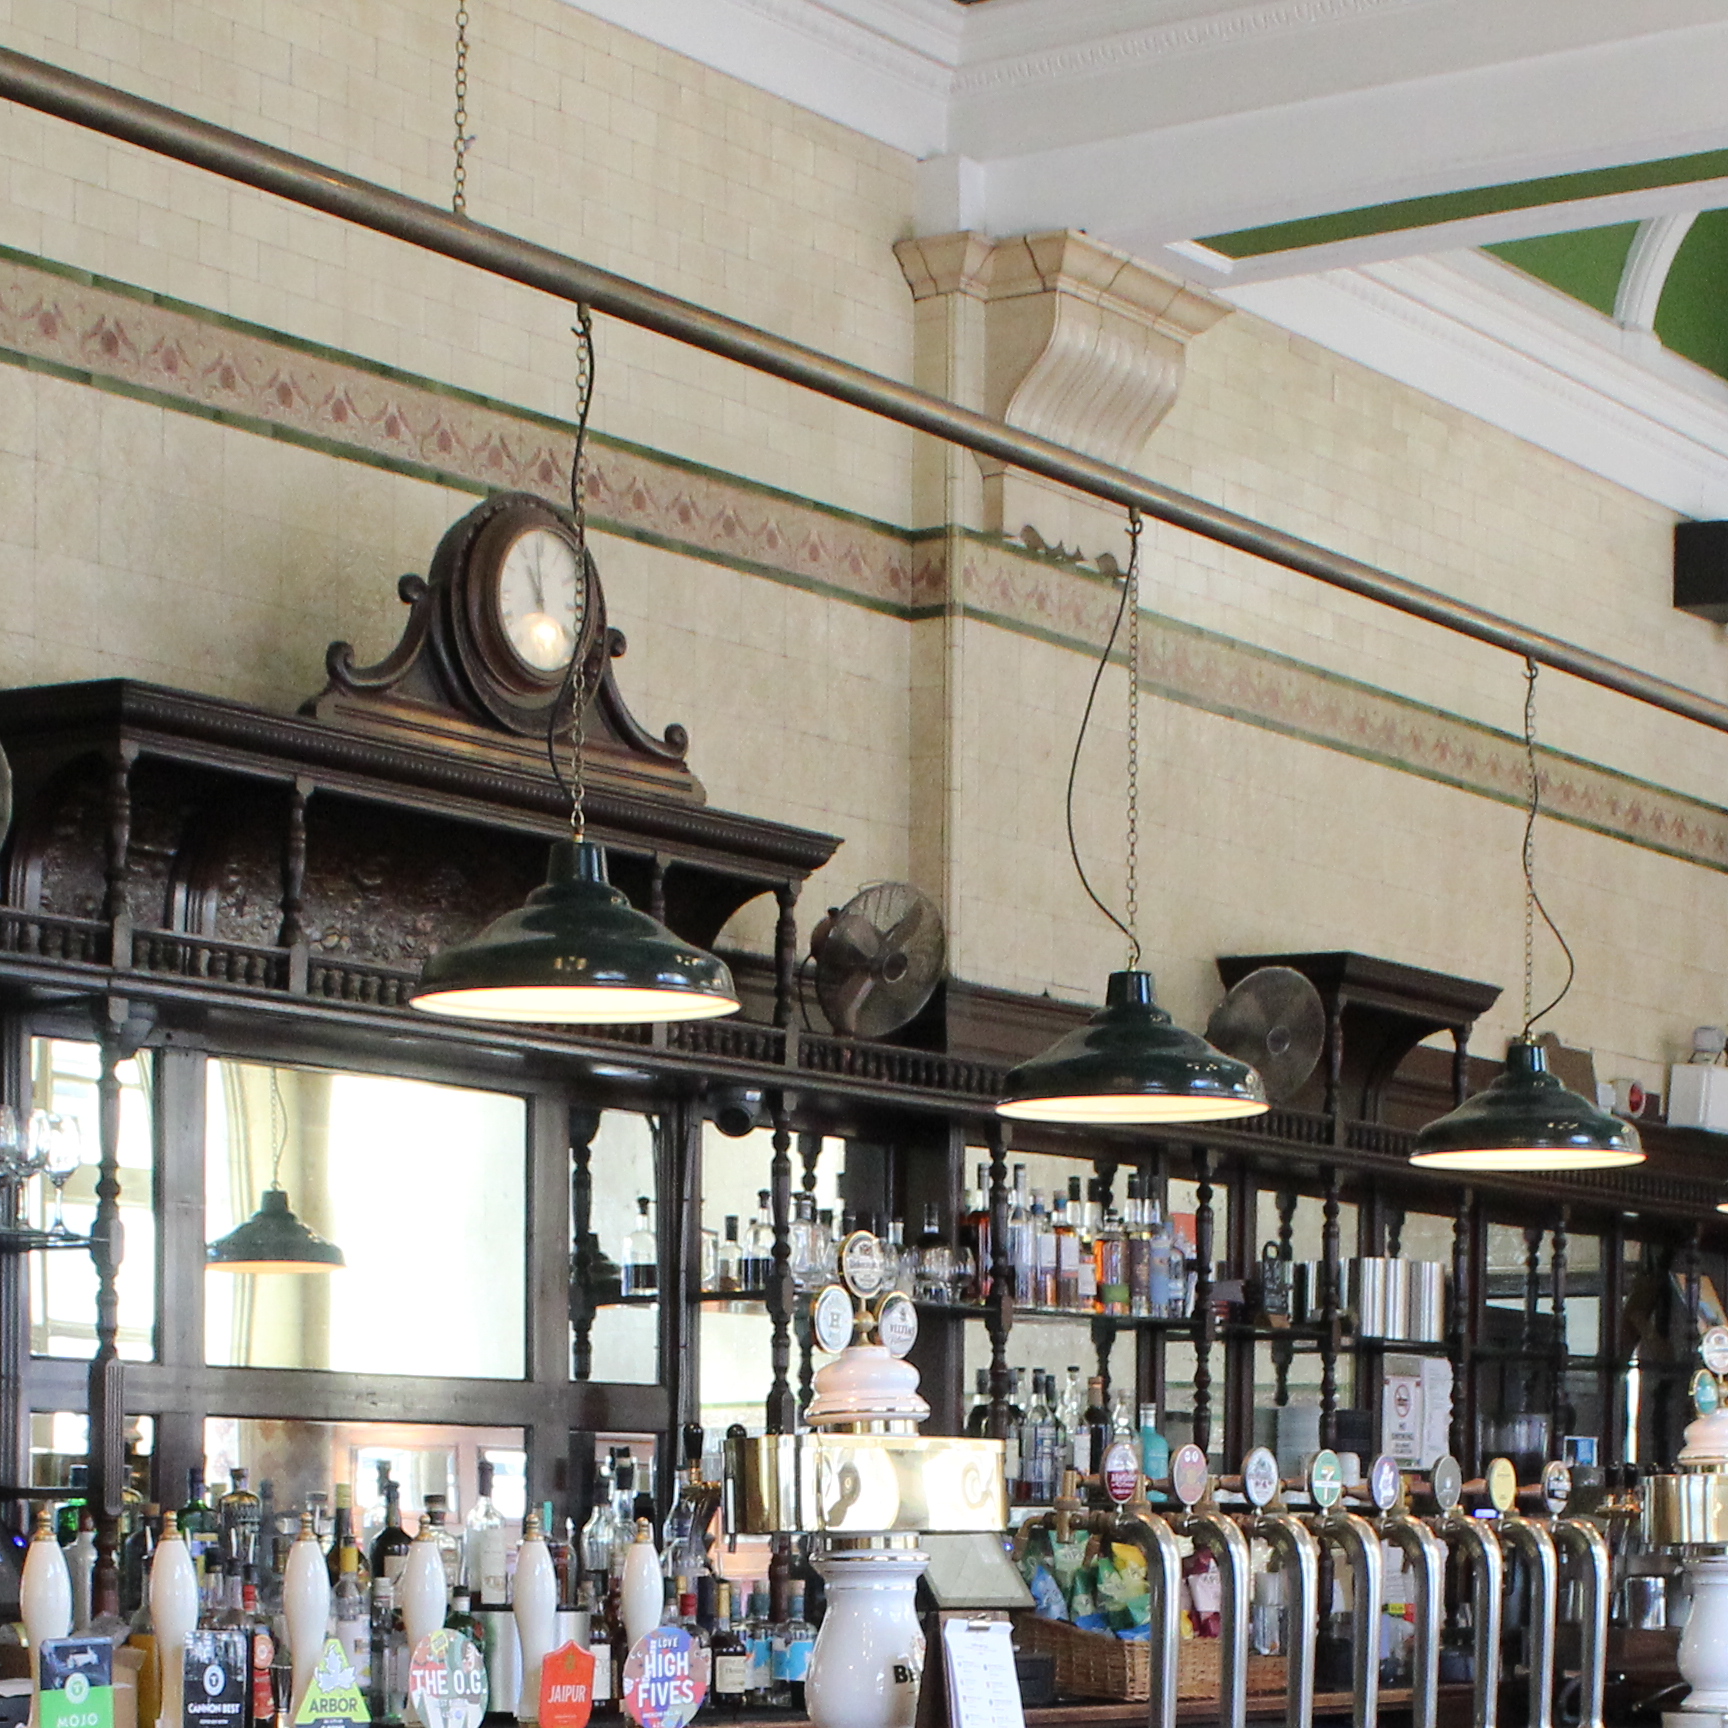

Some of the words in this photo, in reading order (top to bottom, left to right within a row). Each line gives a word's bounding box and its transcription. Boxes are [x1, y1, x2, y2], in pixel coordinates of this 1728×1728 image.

[658, 1637, 679, 1649] LOVE
[645, 1651, 690, 1678] HIGH
[411, 1669, 449, 1695] THE
[453, 1669, 487, 1695] O.G.
[547, 1684, 587, 1704] JAIPUR
[638, 1679, 695, 1709] FIVES
[187, 1703, 222, 1715] CANNON
[222, 1703, 241, 1715] BEST
[308, 1697, 358, 1713] ARBOR
[57, 1712, 99, 1728] MOJO
